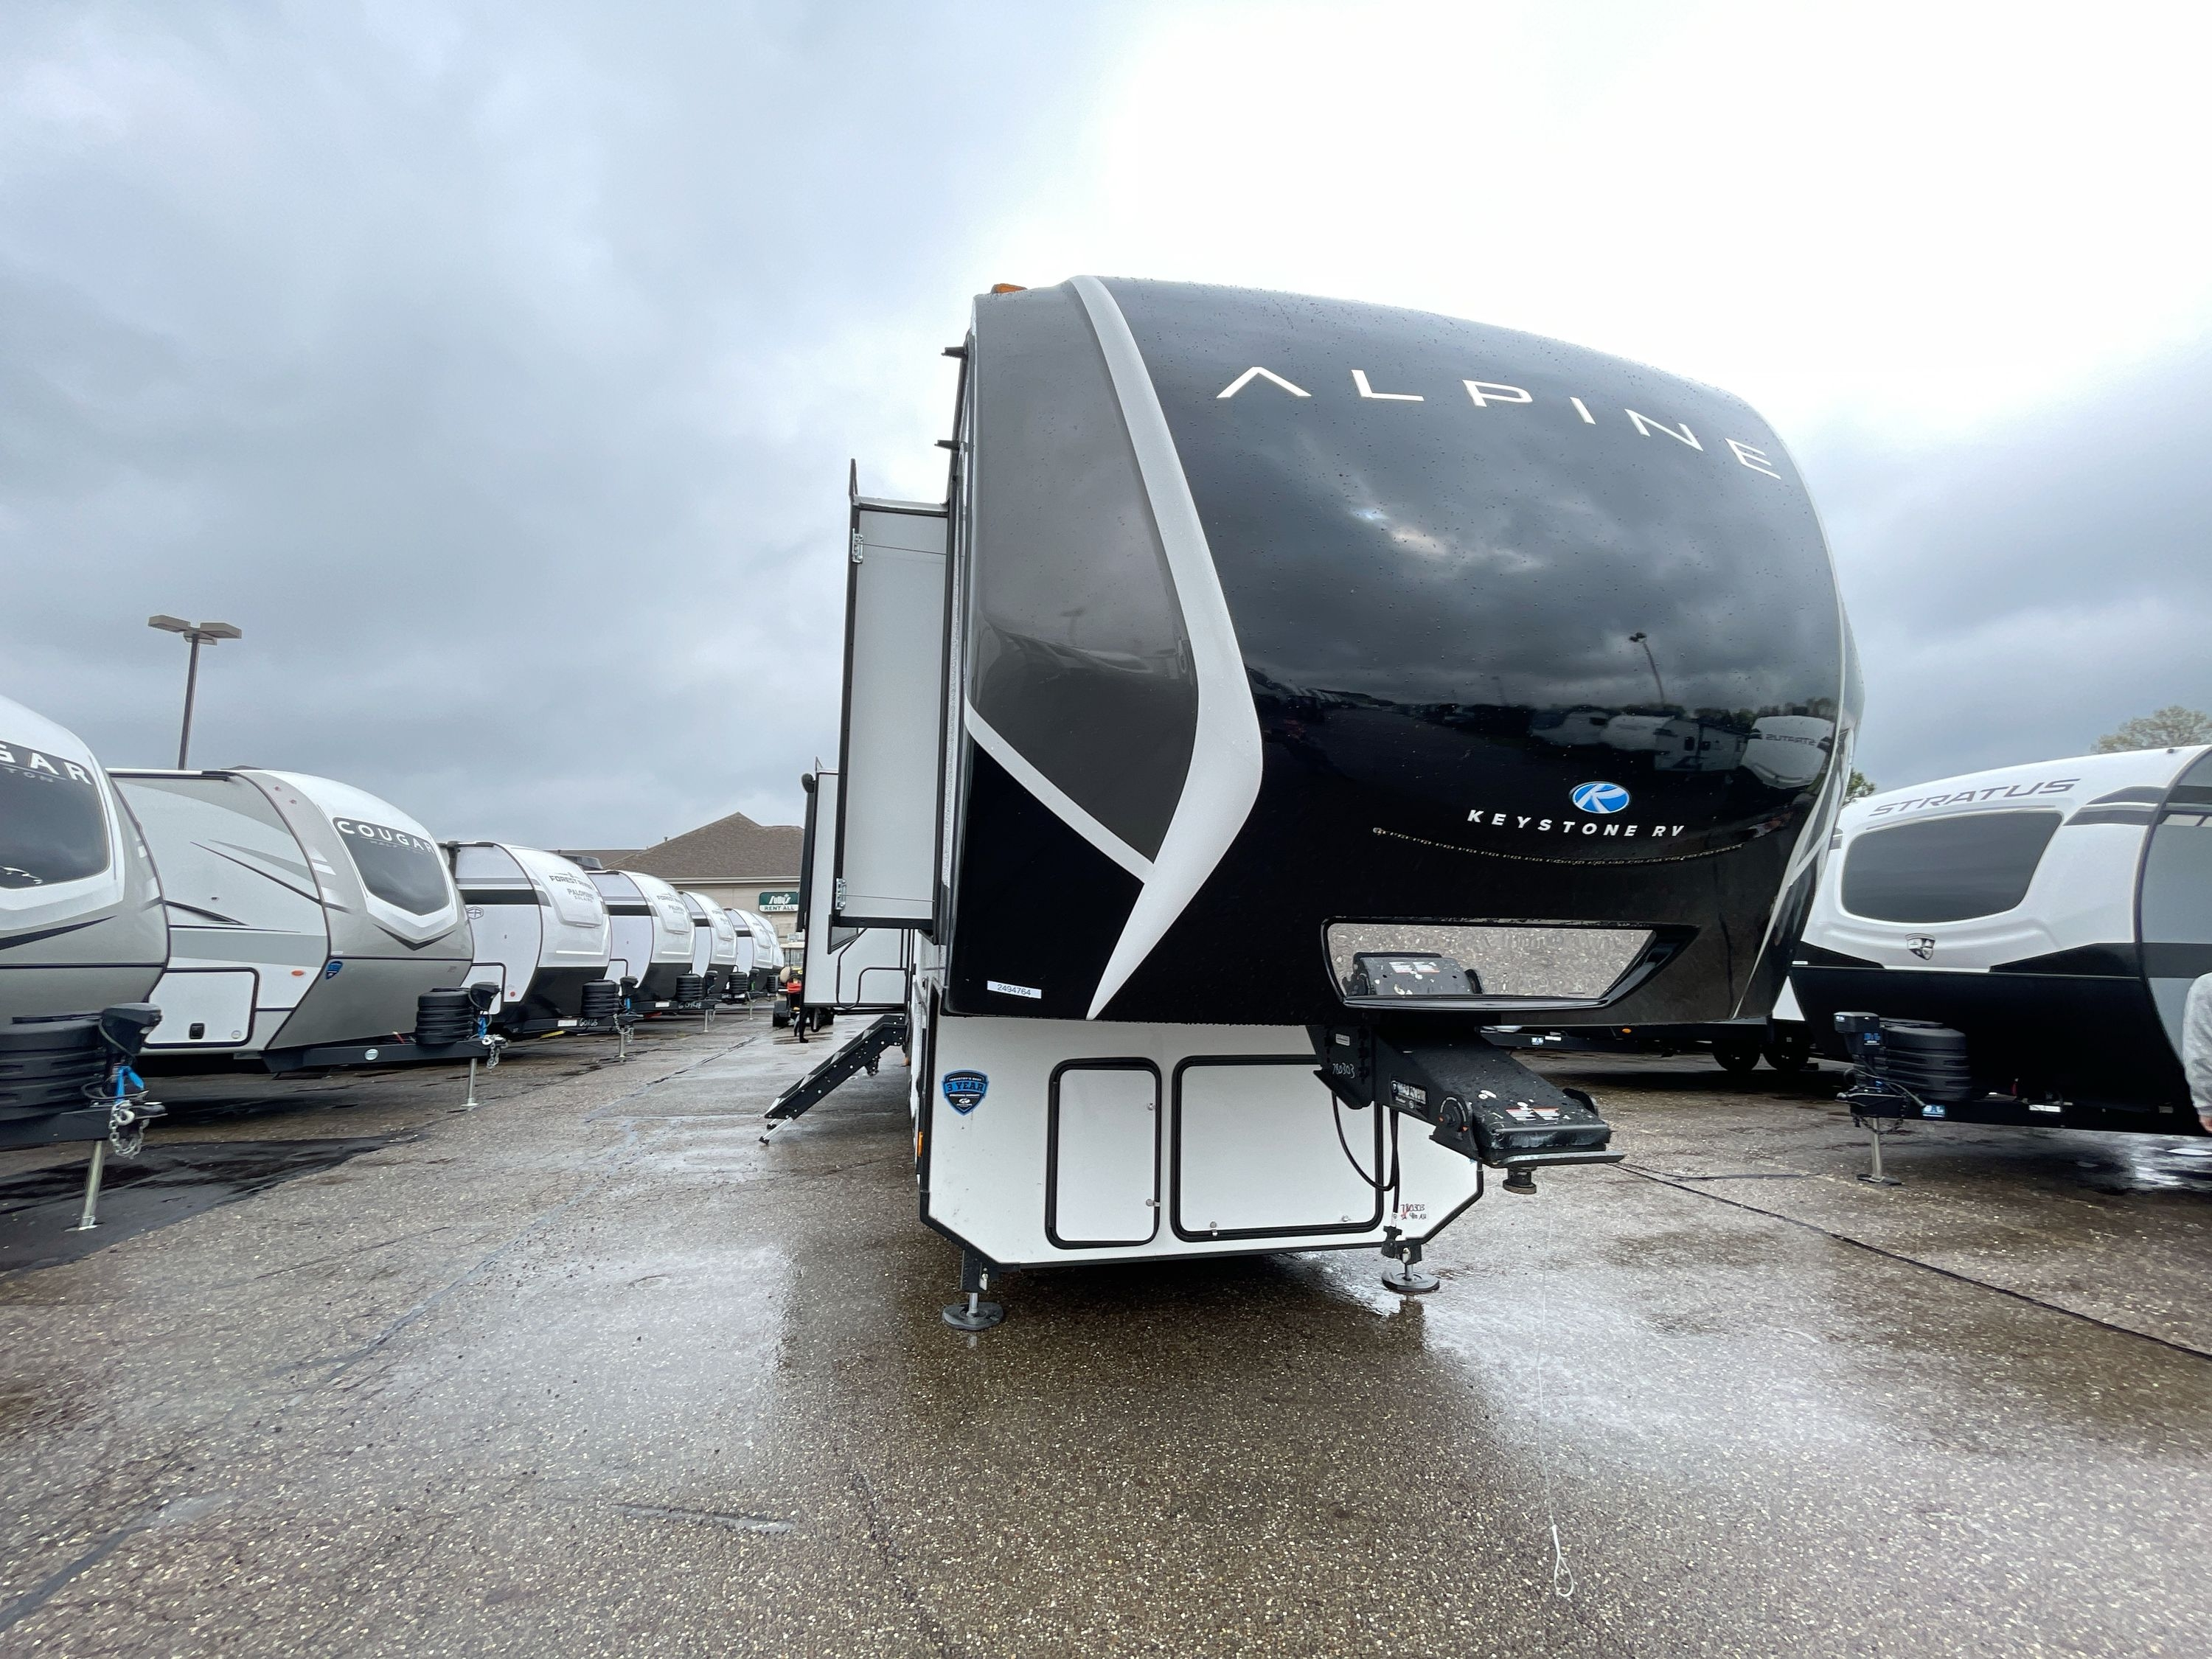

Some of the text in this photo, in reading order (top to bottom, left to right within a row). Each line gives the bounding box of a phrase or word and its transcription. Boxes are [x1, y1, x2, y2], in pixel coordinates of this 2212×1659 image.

[1217, 366, 1781, 480] ALPINE
[1868, 779, 2081, 816] STRATUS
[1467, 810, 1685, 837] KEYSTONE RV
[337, 821, 435, 855] COUGAR
[549, 875, 578, 884] FOREST
[997, 984, 1032, 995] 2494764
[956, 1081, 984, 1091] YEAR
